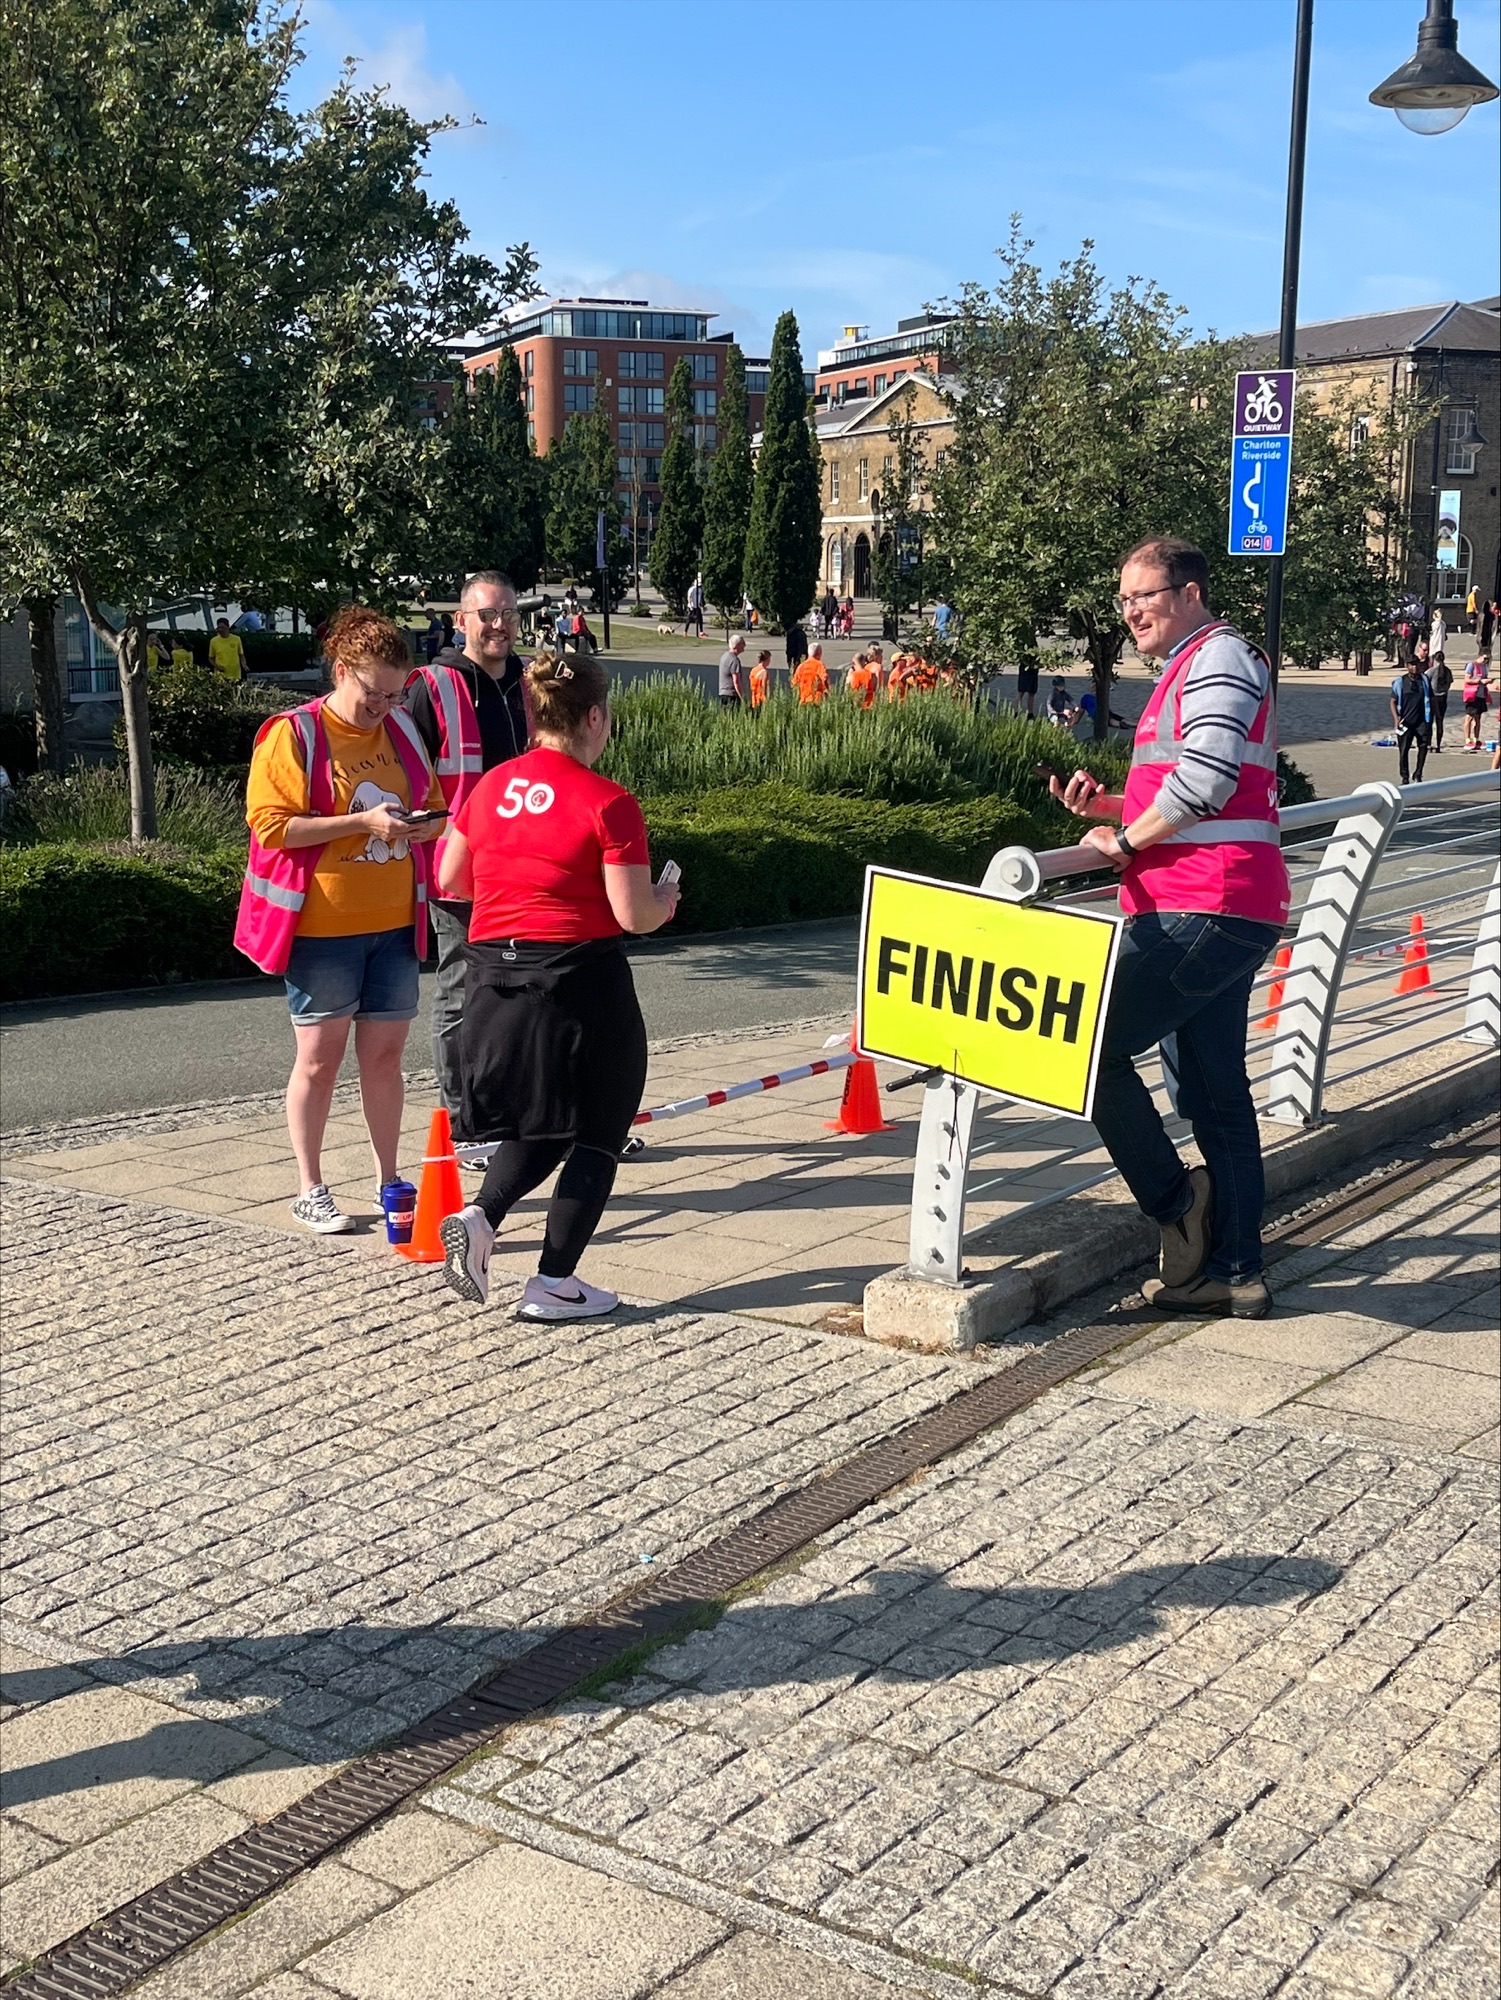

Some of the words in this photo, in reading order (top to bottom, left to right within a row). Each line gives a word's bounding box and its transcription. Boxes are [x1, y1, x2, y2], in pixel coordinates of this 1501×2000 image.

[1243, 424, 1282, 432] QUIETWAY
[1243, 440, 1281, 449] Charlton
[1242, 451, 1281, 460] Riverside
[1243, 539, 1260, 548] Q14
[496, 777, 555, 819] 50
[877, 935, 1086, 1044] FINISH
